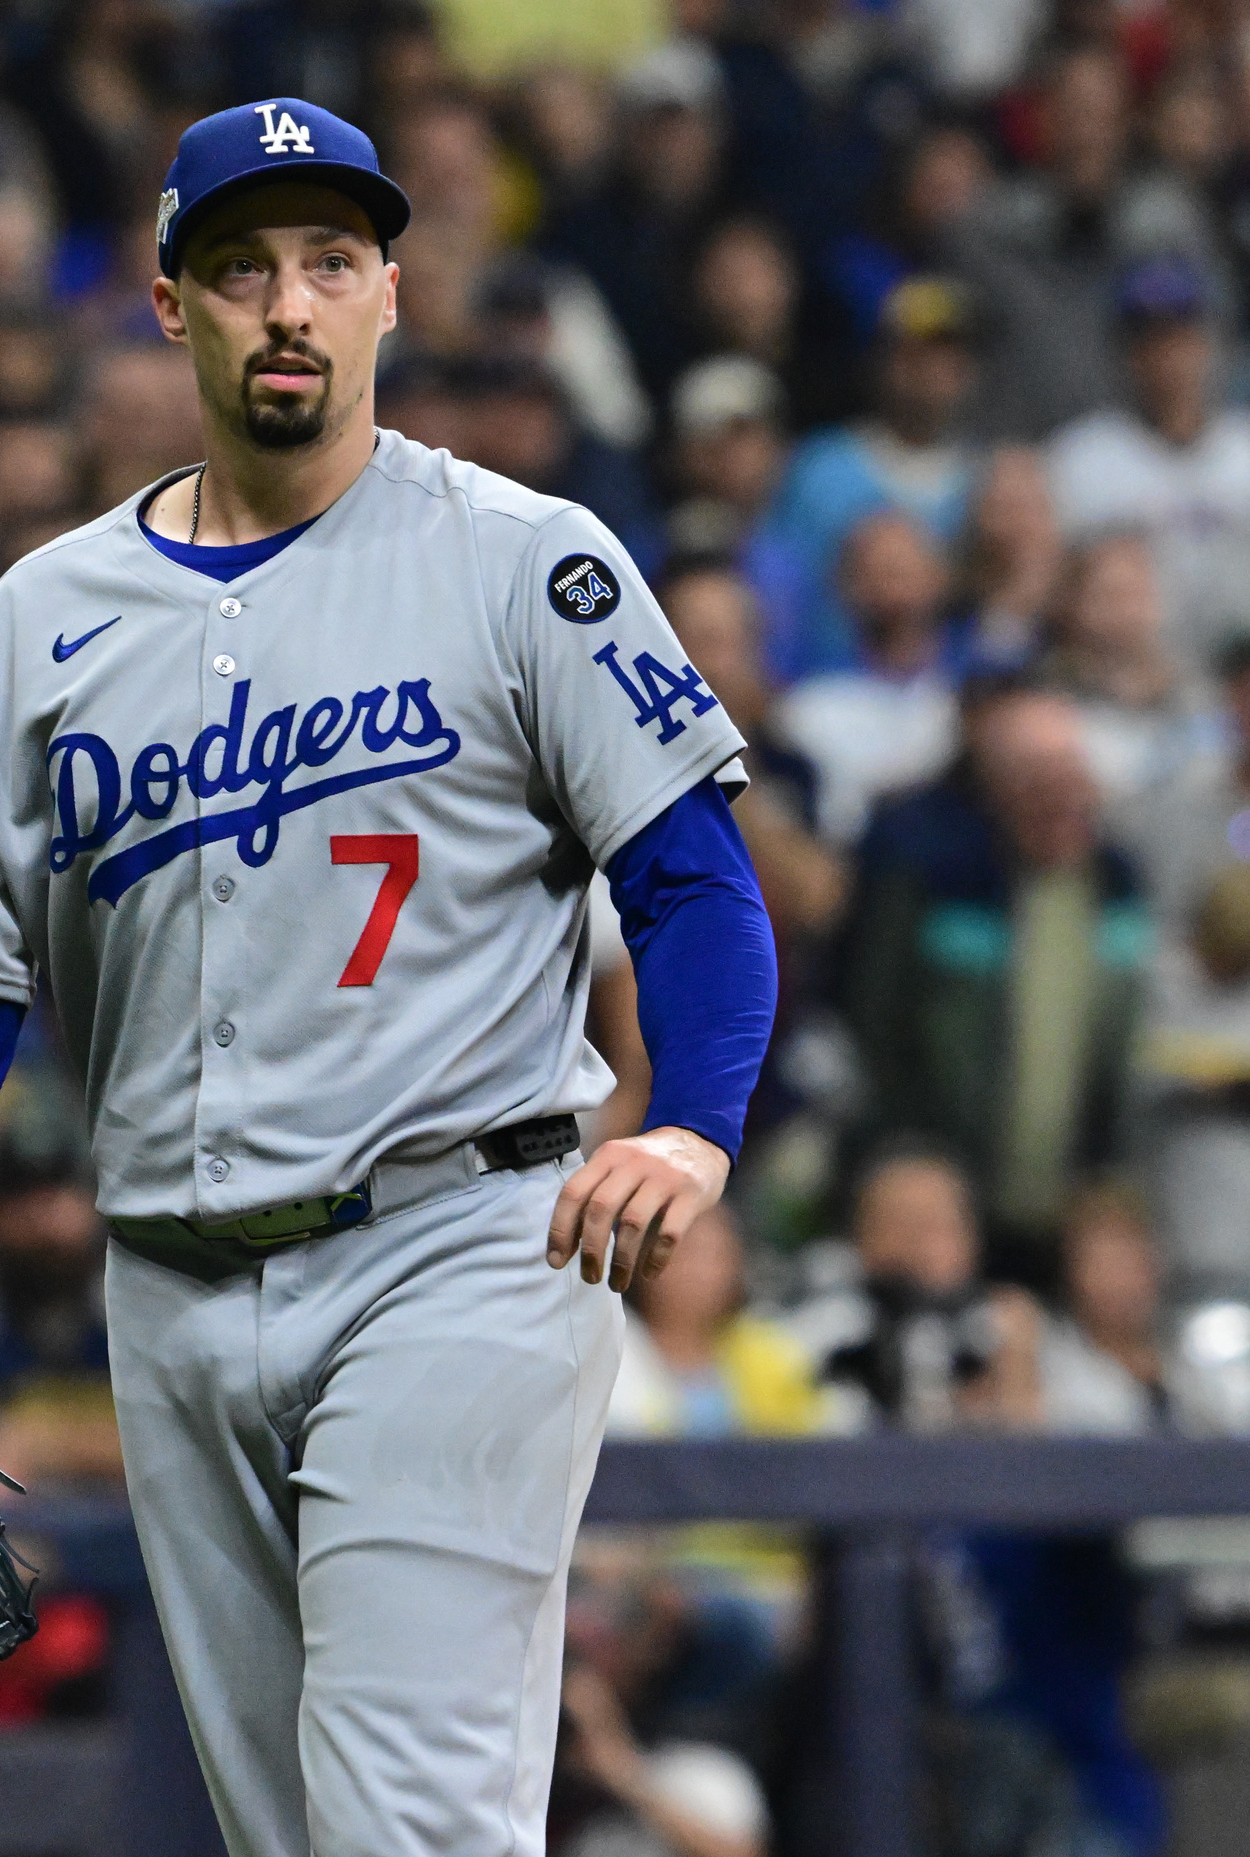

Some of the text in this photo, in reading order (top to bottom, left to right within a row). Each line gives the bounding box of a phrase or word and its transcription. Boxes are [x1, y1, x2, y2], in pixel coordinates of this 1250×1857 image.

[254, 103, 315, 154] LA
[554, 560, 594, 593] FERNANDO
[566, 571, 614, 614] 34
[591, 640, 719, 746] LA
[47, 678, 461, 880] Dodgers
[330, 834, 419, 987] 7
